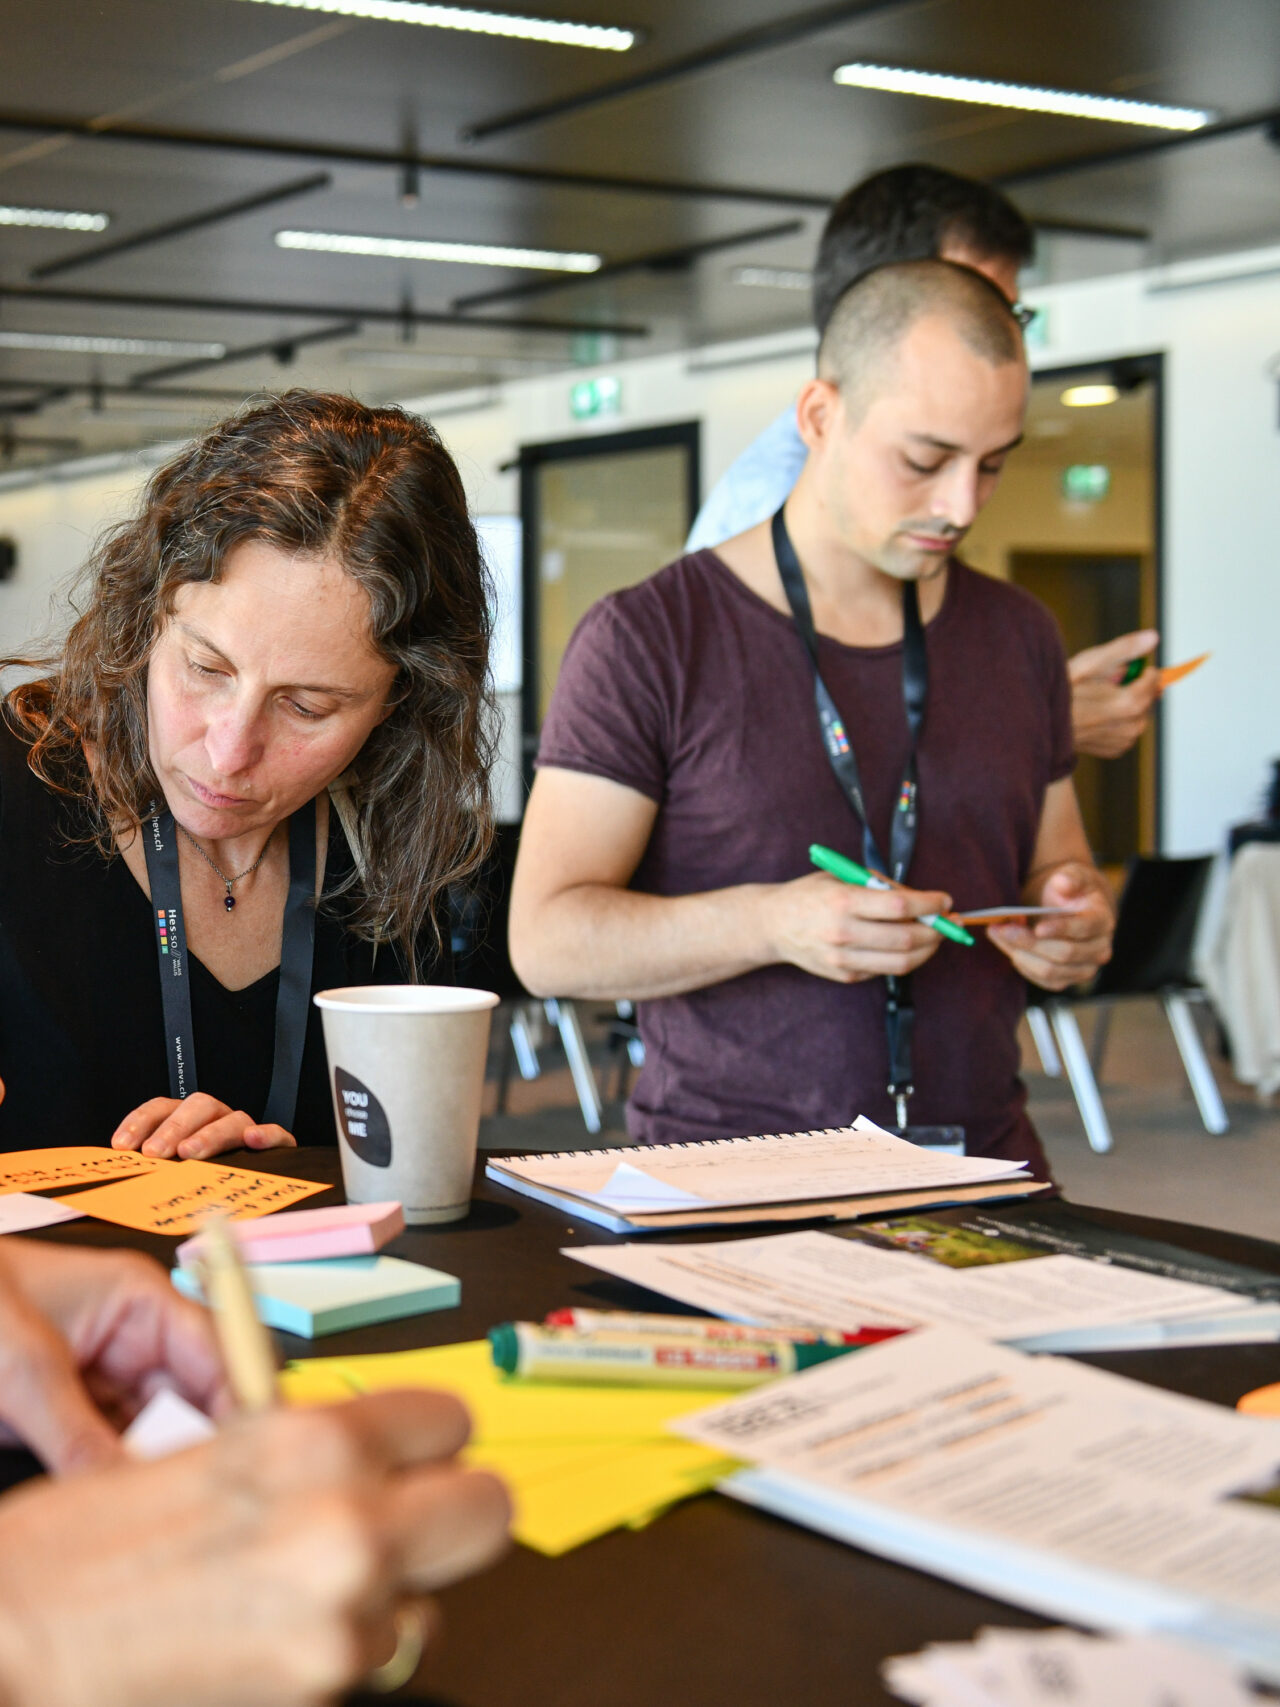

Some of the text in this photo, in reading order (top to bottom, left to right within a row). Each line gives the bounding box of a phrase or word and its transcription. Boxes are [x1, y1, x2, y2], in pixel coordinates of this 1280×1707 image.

[175, 1036, 187, 1098] www.hevs.ch
[341, 1089, 368, 1108] YOU
[347, 1120, 368, 1138] ME
